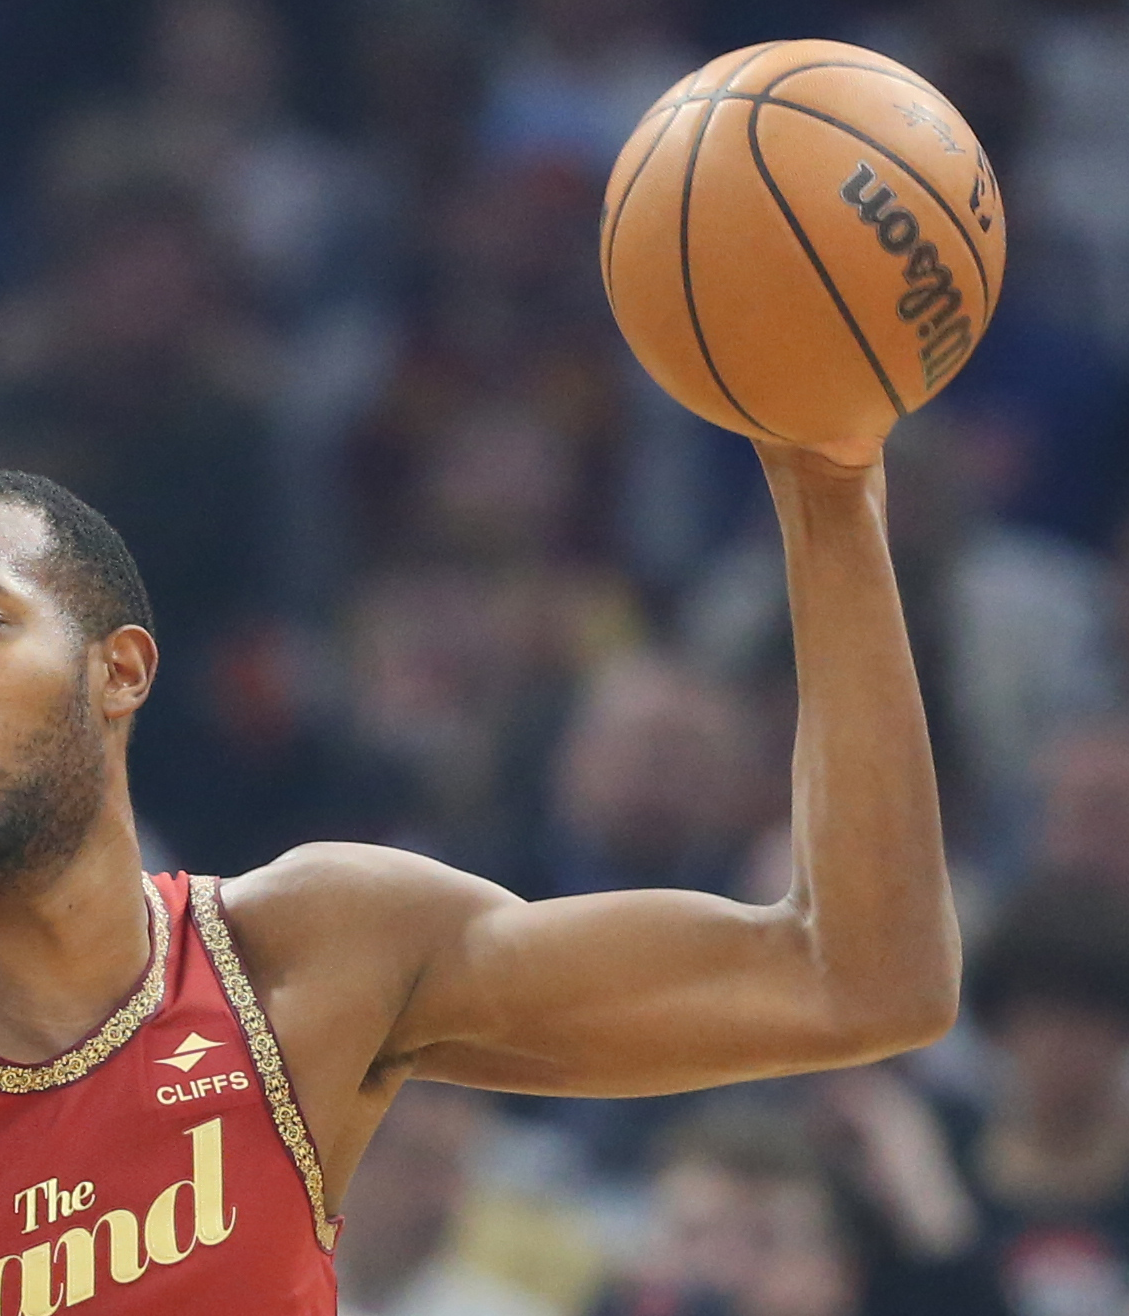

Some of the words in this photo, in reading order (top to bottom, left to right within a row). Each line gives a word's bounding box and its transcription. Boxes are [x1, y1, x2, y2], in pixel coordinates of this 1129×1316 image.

[840, 159, 973, 392] Wilson
[156, 1070, 249, 1105] CLIFFS
[14, 1177, 96, 1234] The
